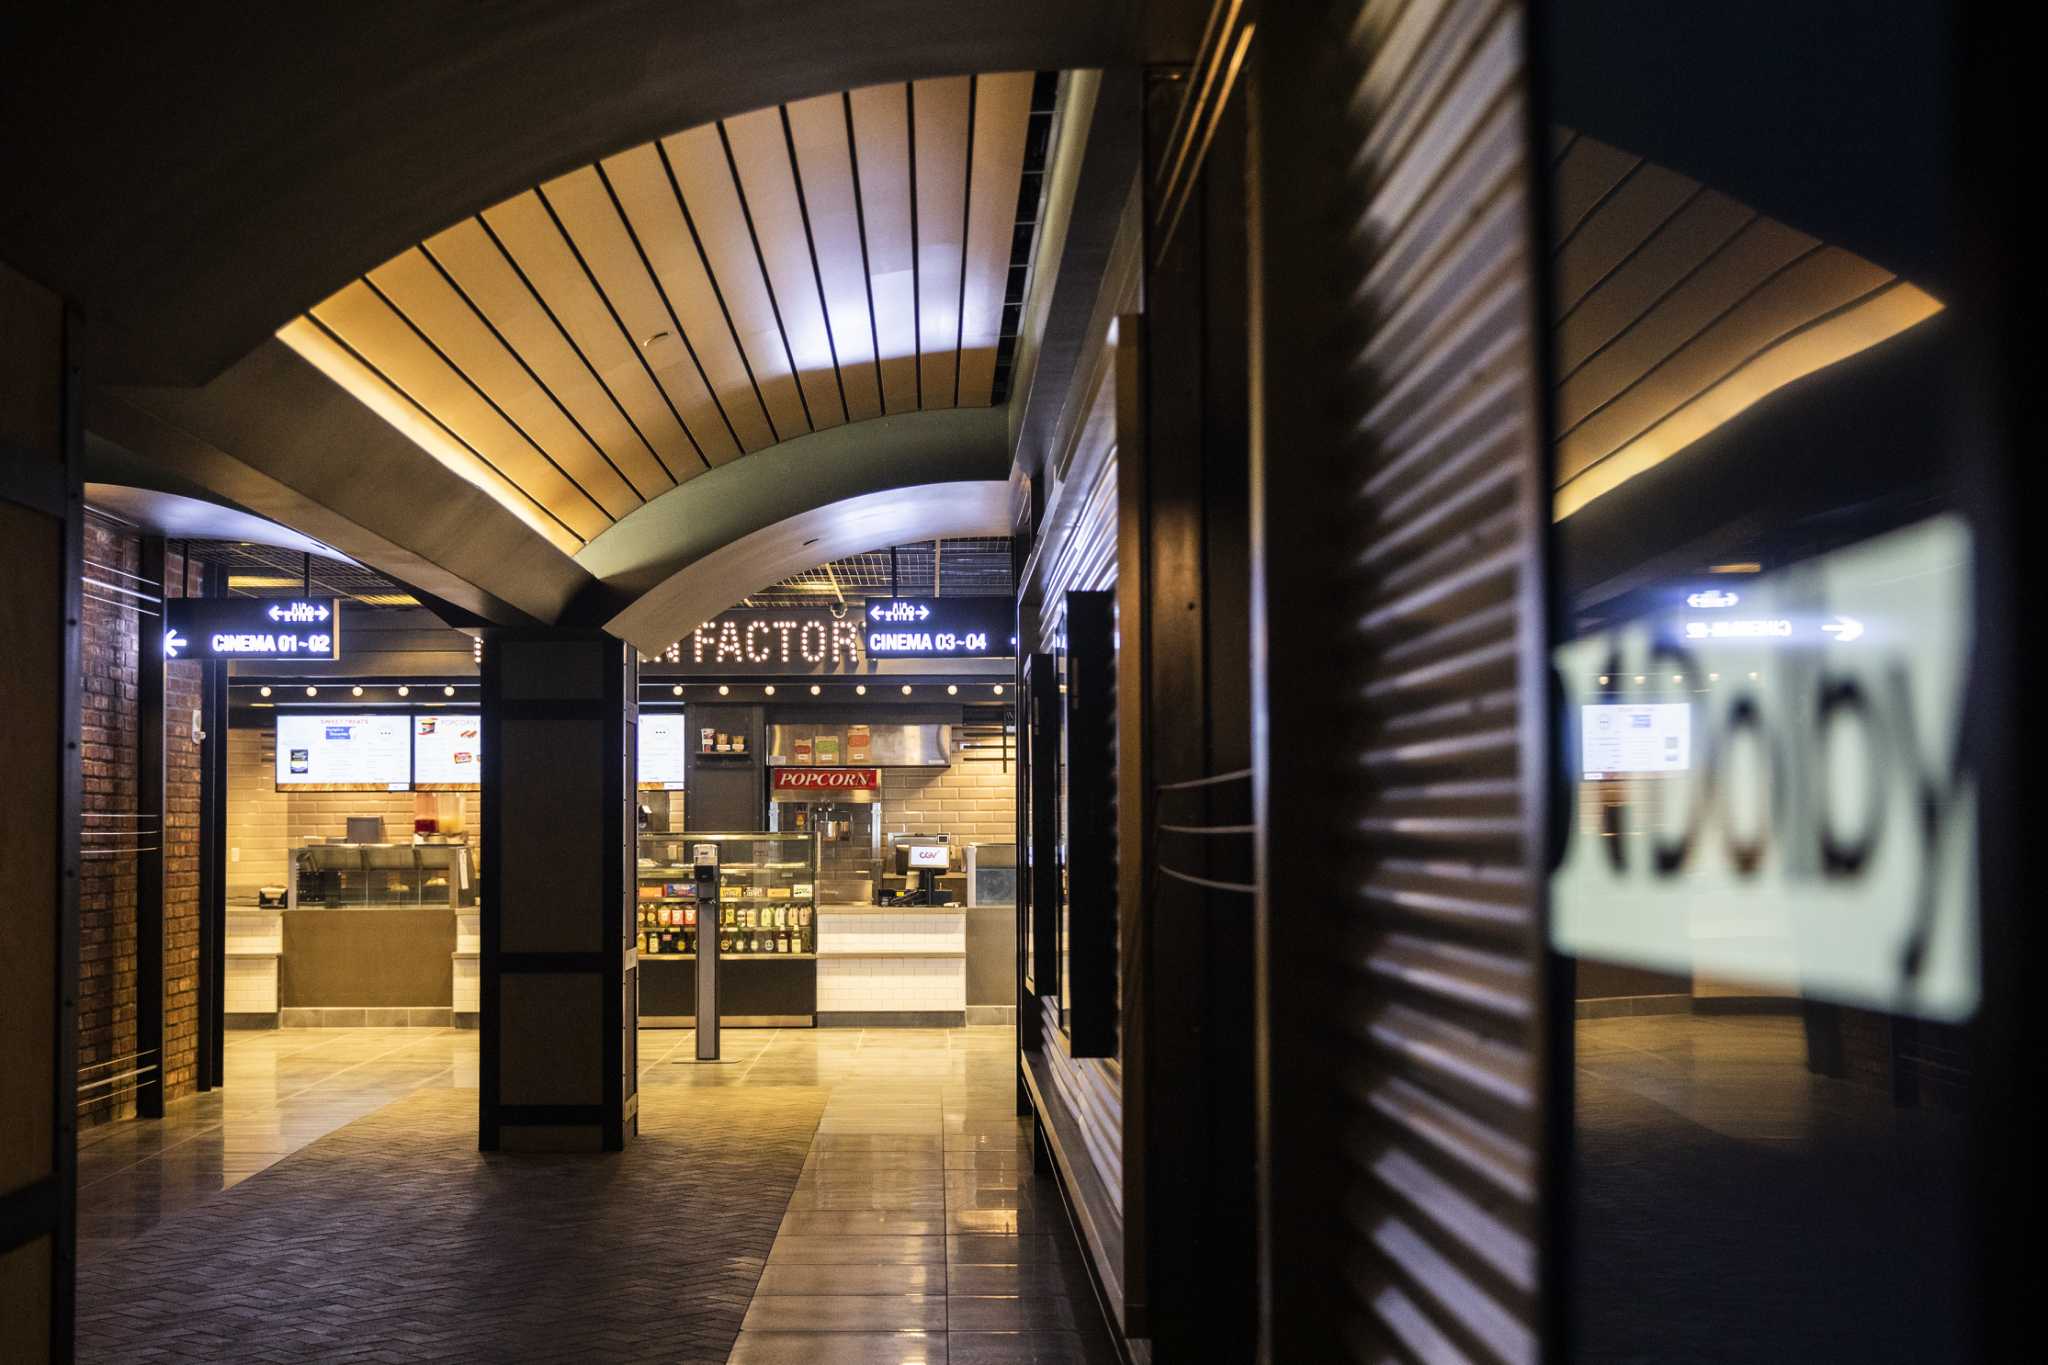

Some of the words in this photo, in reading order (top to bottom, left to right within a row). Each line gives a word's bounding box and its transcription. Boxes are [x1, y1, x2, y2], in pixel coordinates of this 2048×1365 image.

[212, 634, 276, 652] CINEMA
[694, 621, 865, 664] FACTOR
[870, 633, 933, 651] CINEMA
[780, 773, 870, 786] POPCORN
